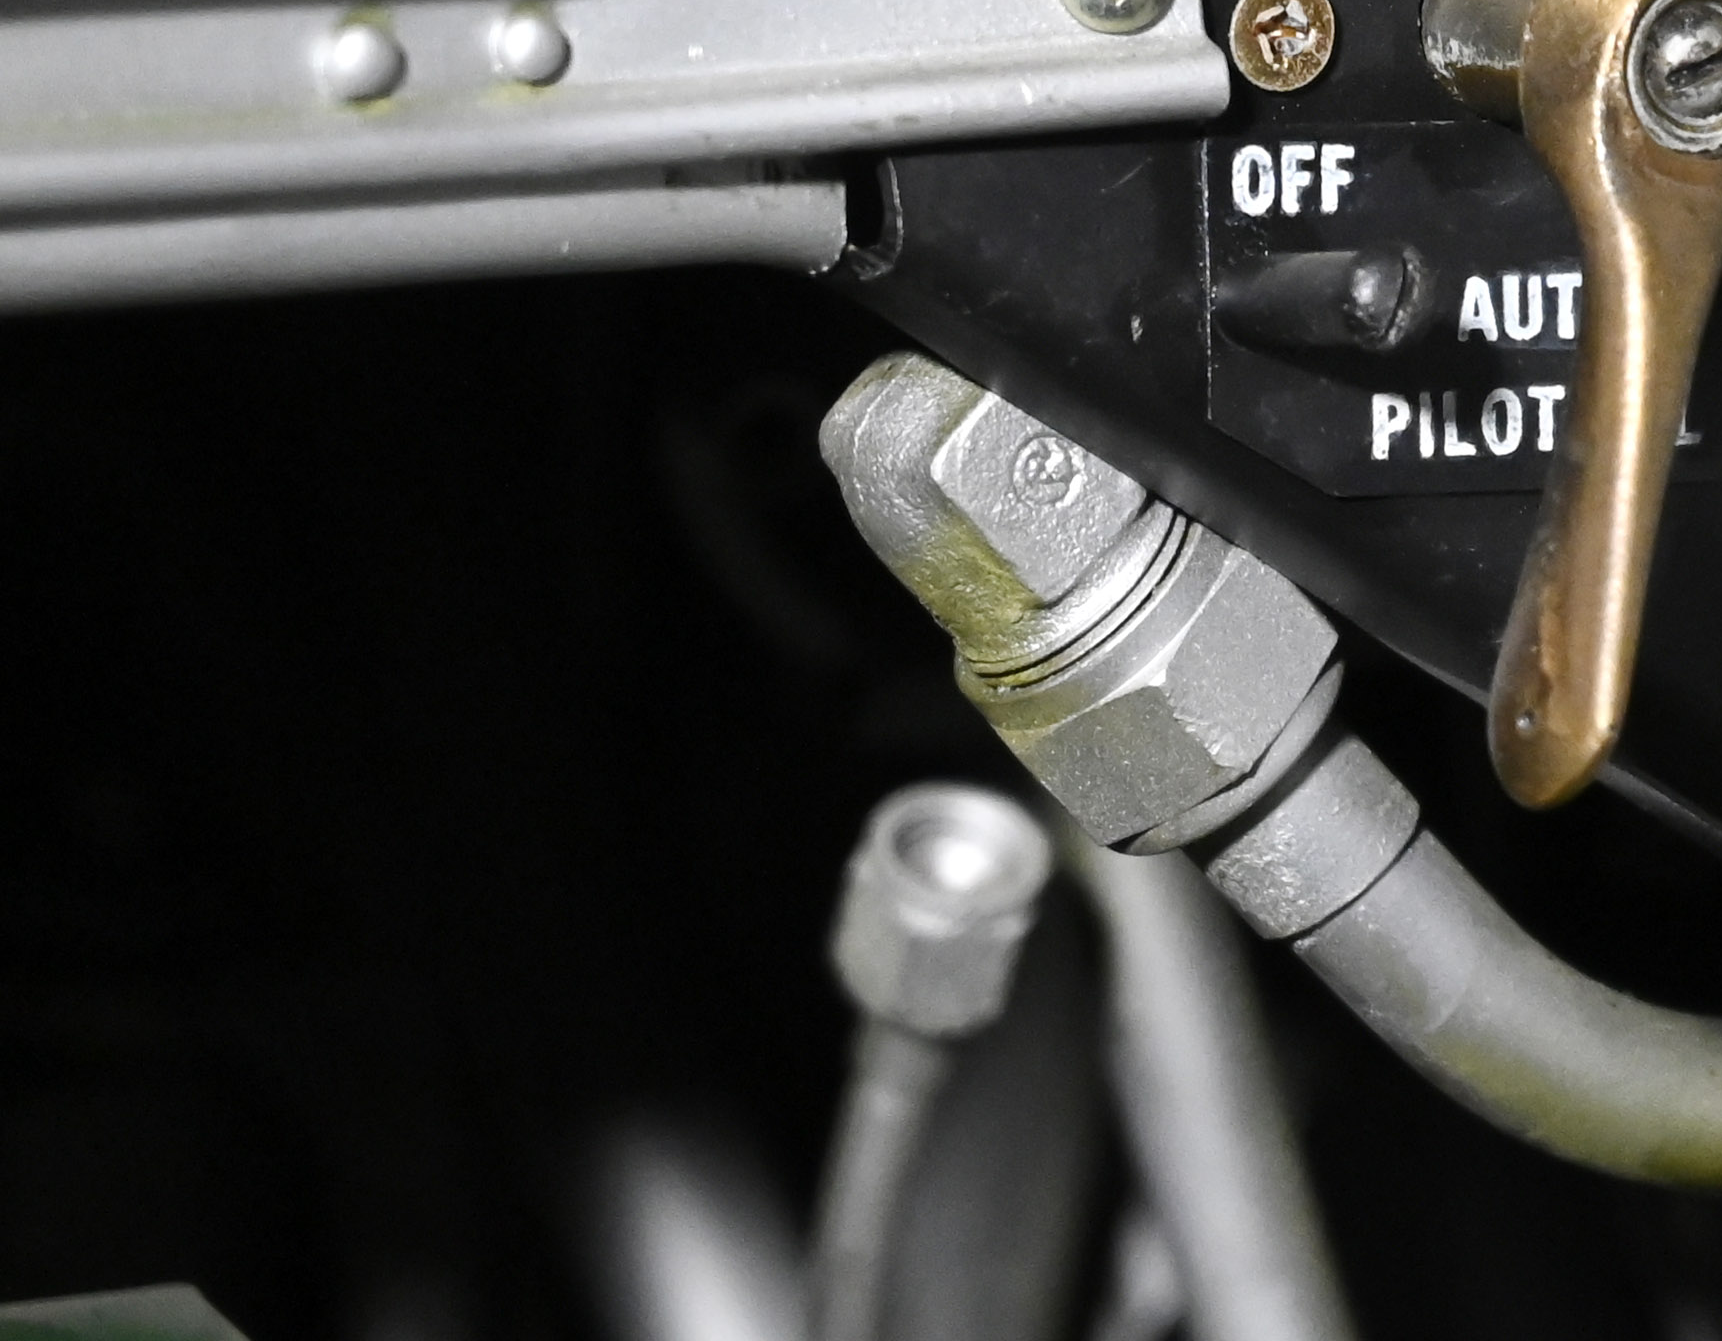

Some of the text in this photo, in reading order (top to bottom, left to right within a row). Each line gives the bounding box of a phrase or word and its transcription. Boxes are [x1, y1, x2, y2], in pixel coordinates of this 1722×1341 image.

[1231, 143, 1355, 217] OFF
[1458, 272, 1582, 344] AUT
[1370, 384, 1566, 463] PILOT
